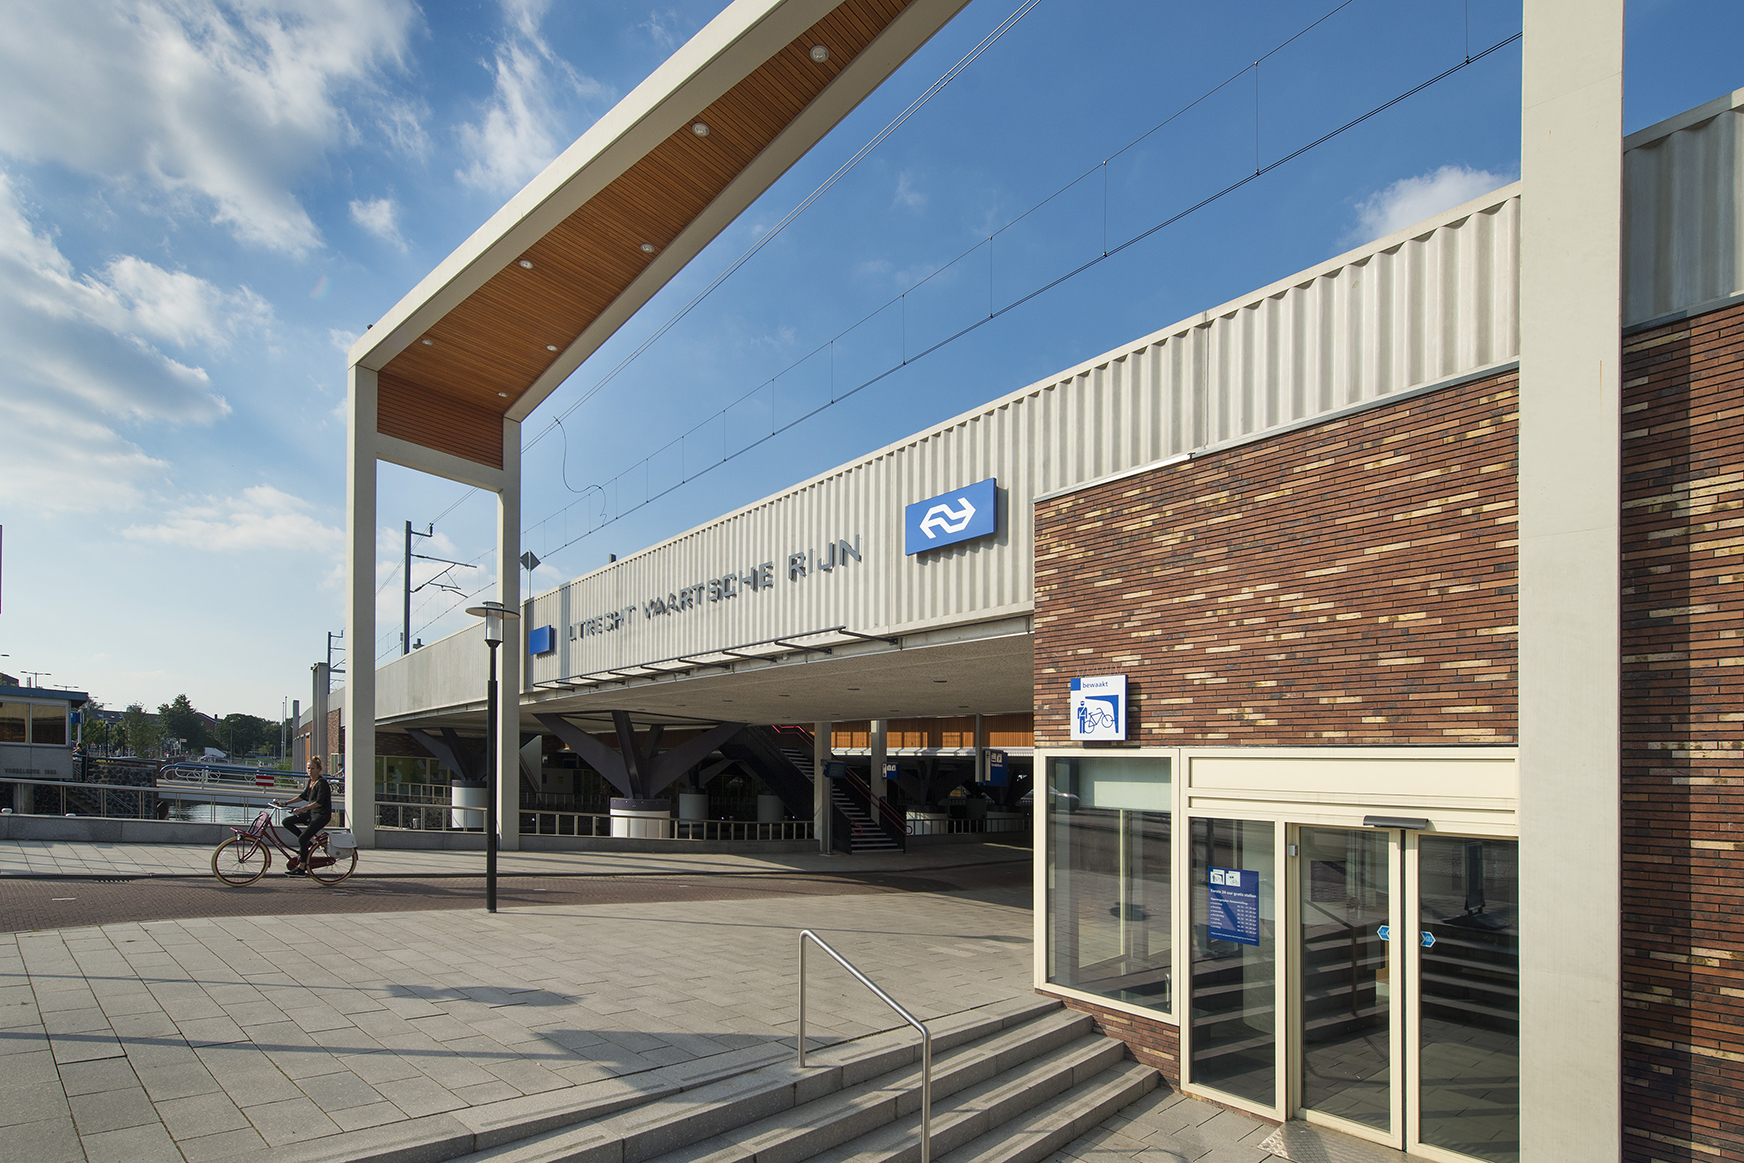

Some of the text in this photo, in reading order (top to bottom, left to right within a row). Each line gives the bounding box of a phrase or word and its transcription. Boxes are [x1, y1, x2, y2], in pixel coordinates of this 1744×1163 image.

[567, 534, 862, 642] UTRECHT VAARTSCHE RIJN
[1082, 681, 1109, 689] bewaakt
